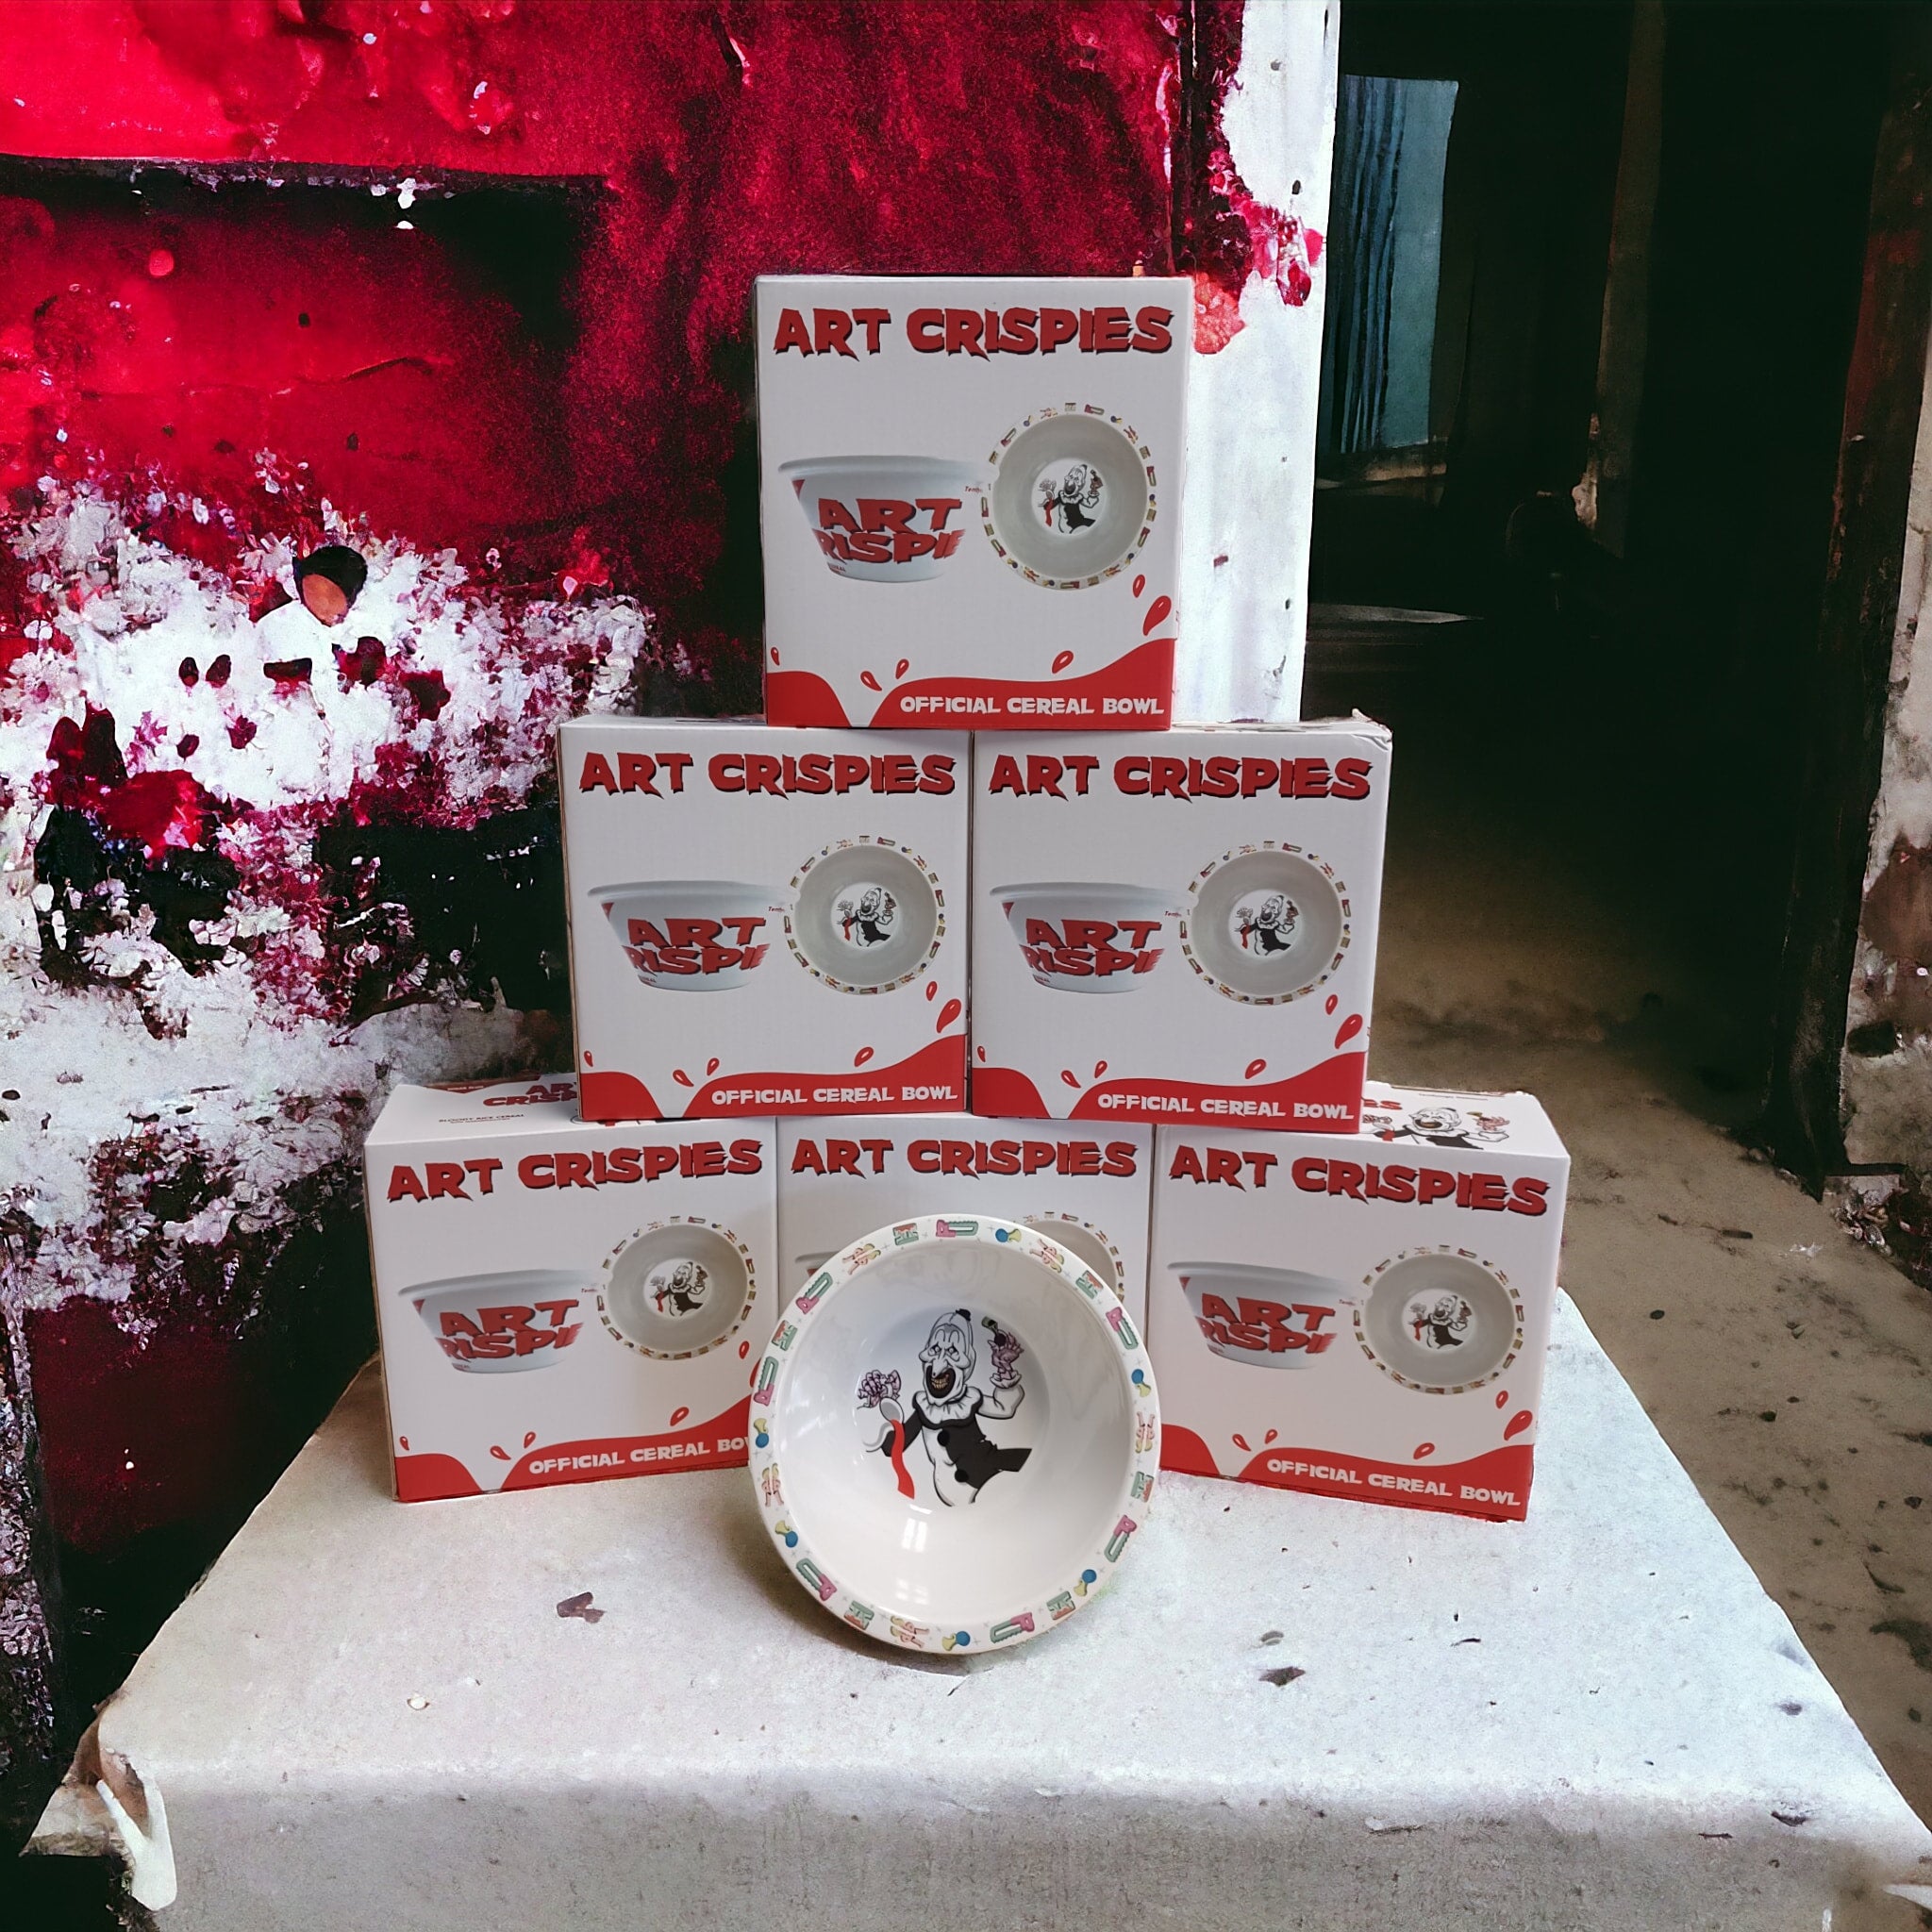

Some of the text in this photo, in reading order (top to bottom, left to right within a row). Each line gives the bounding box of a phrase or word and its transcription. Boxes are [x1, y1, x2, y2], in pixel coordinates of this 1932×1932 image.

[774, 306, 1174, 361] ART CRISPIES
[818, 498, 962, 534] ART
[900, 696, 1164, 716] OFFICIAL CEREAL BOWL
[578, 752, 957, 800] ART CRISPIES
[988, 754, 1374, 803] ART CRISPIES
[627, 917, 767, 950] ART
[1025, 918, 1162, 952] ART
[483, 1092, 577, 1106] CRISP
[525, 1081, 577, 1095] AR
[711, 1085, 958, 1106] OFFICIAL CEREAL BOWL
[1097, 1093, 1195, 1113] OFFICIAL
[1200, 1098, 1286, 1117] CEREAL
[1293, 1102, 1355, 1121] BOWL
[387, 1139, 763, 1204] ART CRISPIES
[791, 1139, 1138, 1180] ART CRISPIES
[1169, 1144, 1551, 1217] ART CRISPIES
[440, 1299, 580, 1336] ART
[1202, 1292, 1337, 1332] ART
[528, 1436, 748, 1474] OFFICIAL CEREAL BO
[1267, 1459, 1521, 1507] OFFICIAL CEREAL BOWL
